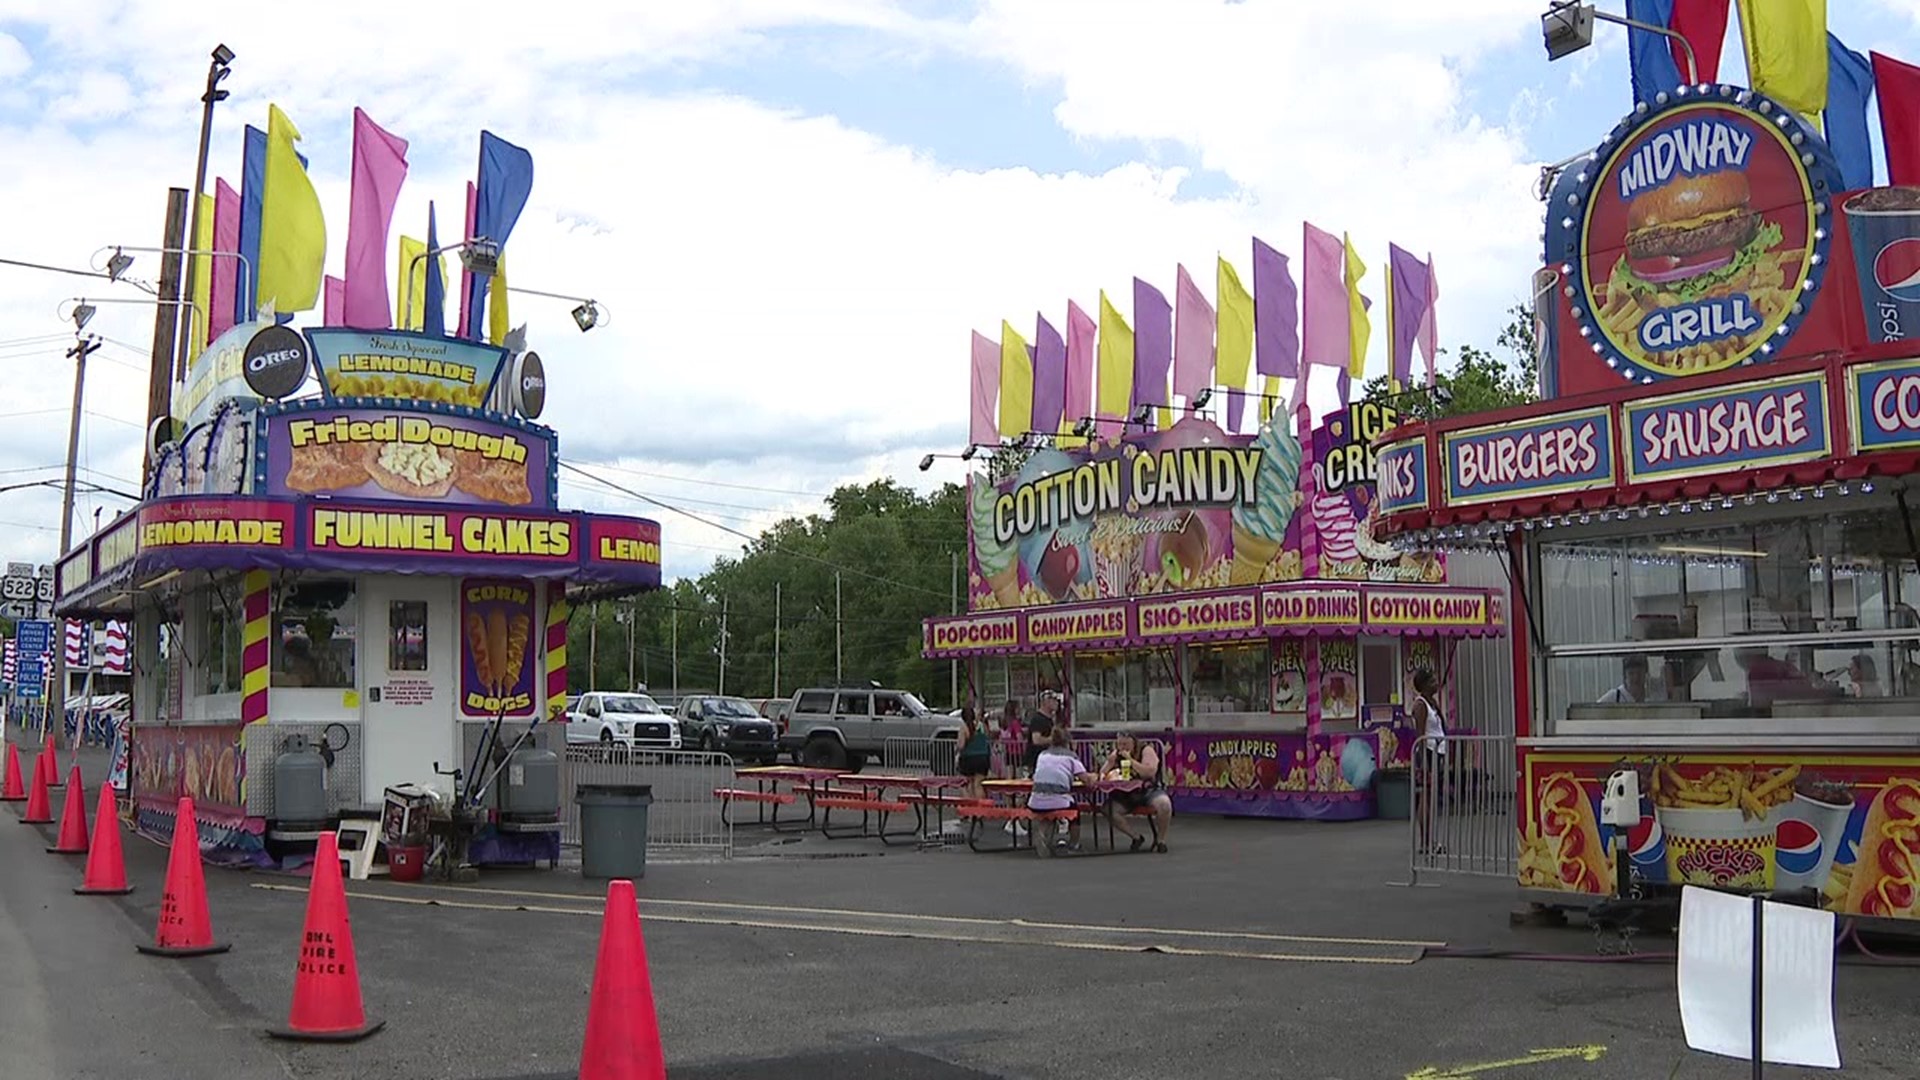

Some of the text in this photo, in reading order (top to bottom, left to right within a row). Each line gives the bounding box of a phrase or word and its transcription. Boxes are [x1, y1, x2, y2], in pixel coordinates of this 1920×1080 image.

[1619, 119, 1752, 198] MIDWAY
[1640, 299, 1758, 348] GRILL
[250, 349, 300, 371] OREO
[339, 354, 476, 384] LEMONADE
[1873, 376, 1920, 432] CO
[1351, 402, 1397, 441] ICE
[1642, 391, 1808, 464] SAUSAGE
[288, 416, 528, 465] Fried Dough
[1457, 422, 1597, 488] BURGERS
[994, 449, 1265, 544] COTTON CANDY
[141, 519, 283, 546] LEMONADE
[314, 509, 570, 555] FUNNEL CAKES
[6, 580, 34, 596] 522
[467, 585, 529, 604] CORN
[1143, 602, 1253, 630] SNO-KONES
[1265, 596, 1358, 618] COLD DRINKS
[1371, 597, 1431, 618] COTTON
[1434, 597, 1481, 618] CANDY
[937, 621, 1014, 645] POPCORN
[1031, 610, 1123, 637] CANDY APPLES
[1281, 642, 1300, 655] ICE
[1411, 641, 1432, 655] POP
[466, 692, 531, 712] DOGS
[1208, 740, 1278, 759] CANDY APPLES
[1677, 848, 1764, 879] BUCKET
